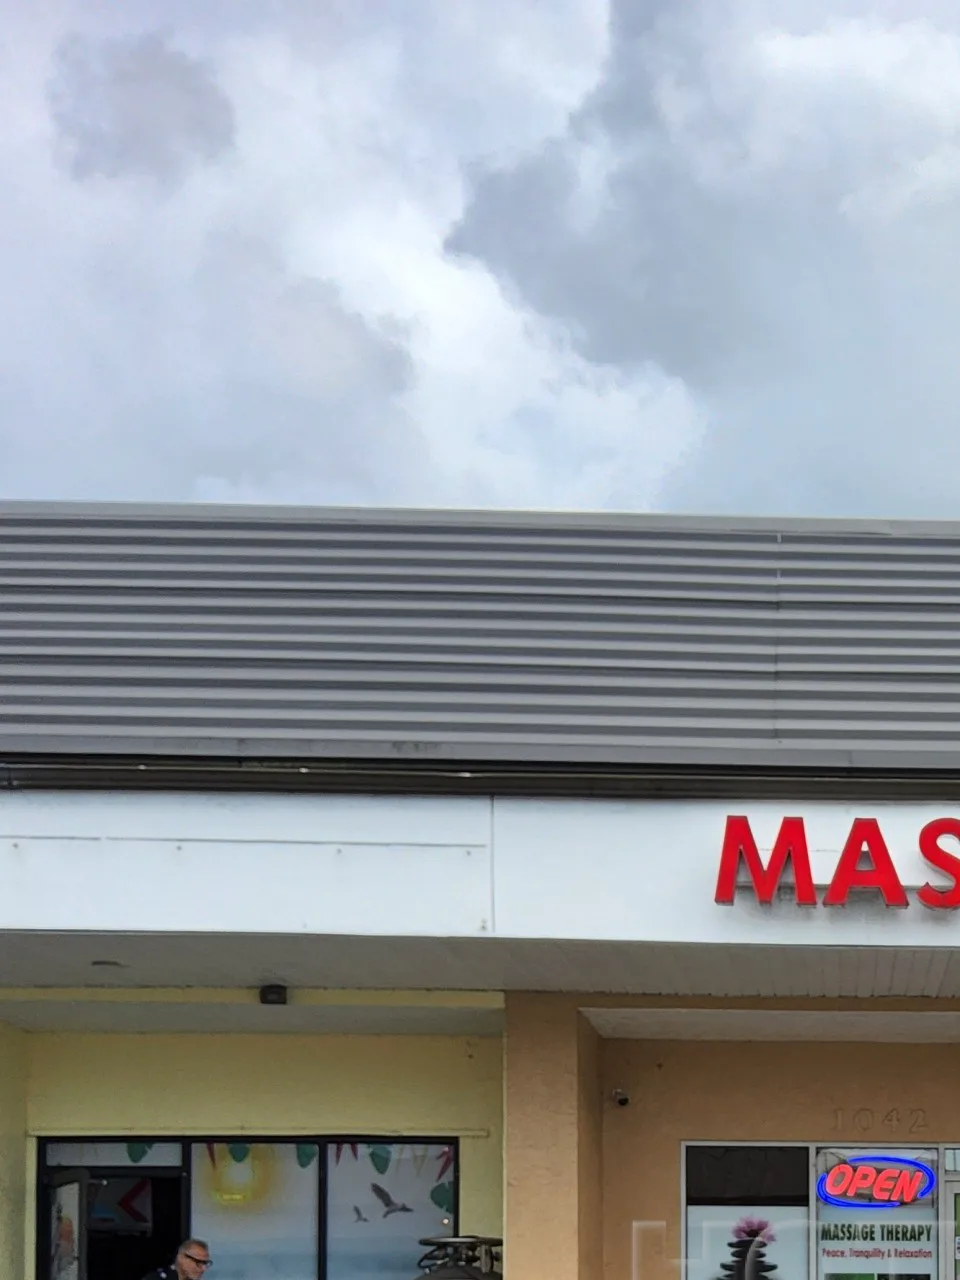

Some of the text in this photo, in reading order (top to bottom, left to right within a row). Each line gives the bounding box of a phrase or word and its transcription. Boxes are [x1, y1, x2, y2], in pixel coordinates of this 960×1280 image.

[832, 1107, 929, 1134] 1042
[825, 1163, 923, 1203] OPEN
[820, 1223, 933, 1243] MASSAGE THERAPY
[894, 1248, 933, 1259] Relaxation
